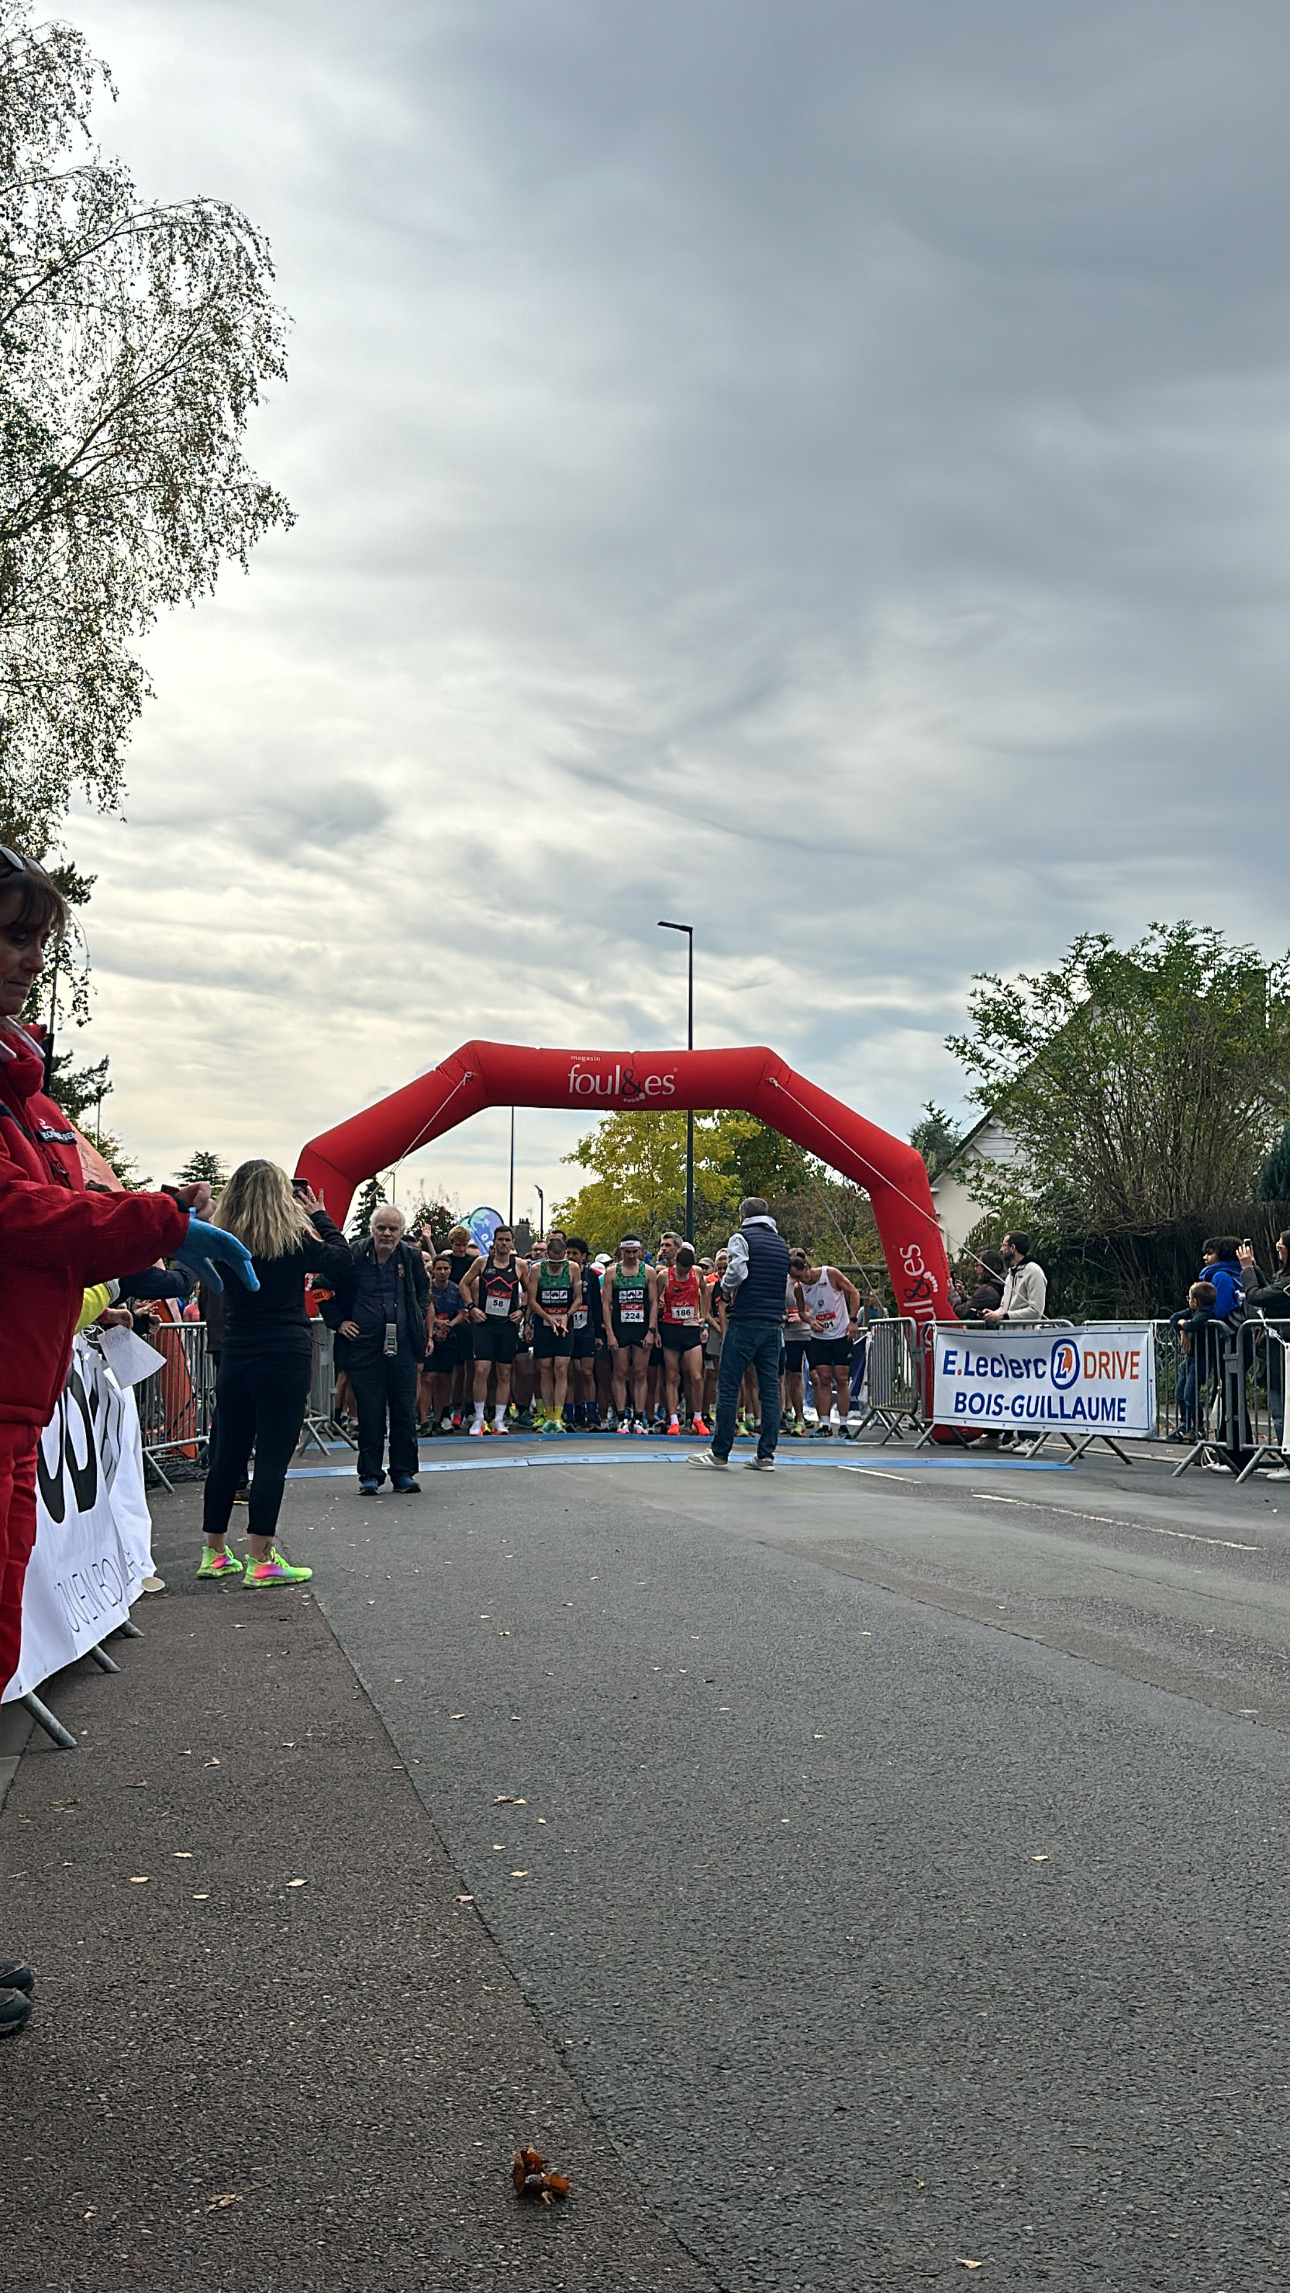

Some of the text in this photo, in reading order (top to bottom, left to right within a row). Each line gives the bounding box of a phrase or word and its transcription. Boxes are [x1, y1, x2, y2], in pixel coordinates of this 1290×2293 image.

[493, 1300, 504, 1308] 58
[943, 1349, 1047, 1380] E.Leclerc
[1084, 1350, 1140, 1380] DRIVE
[954, 1391, 1127, 1423] BOIS-GUILLAUME
